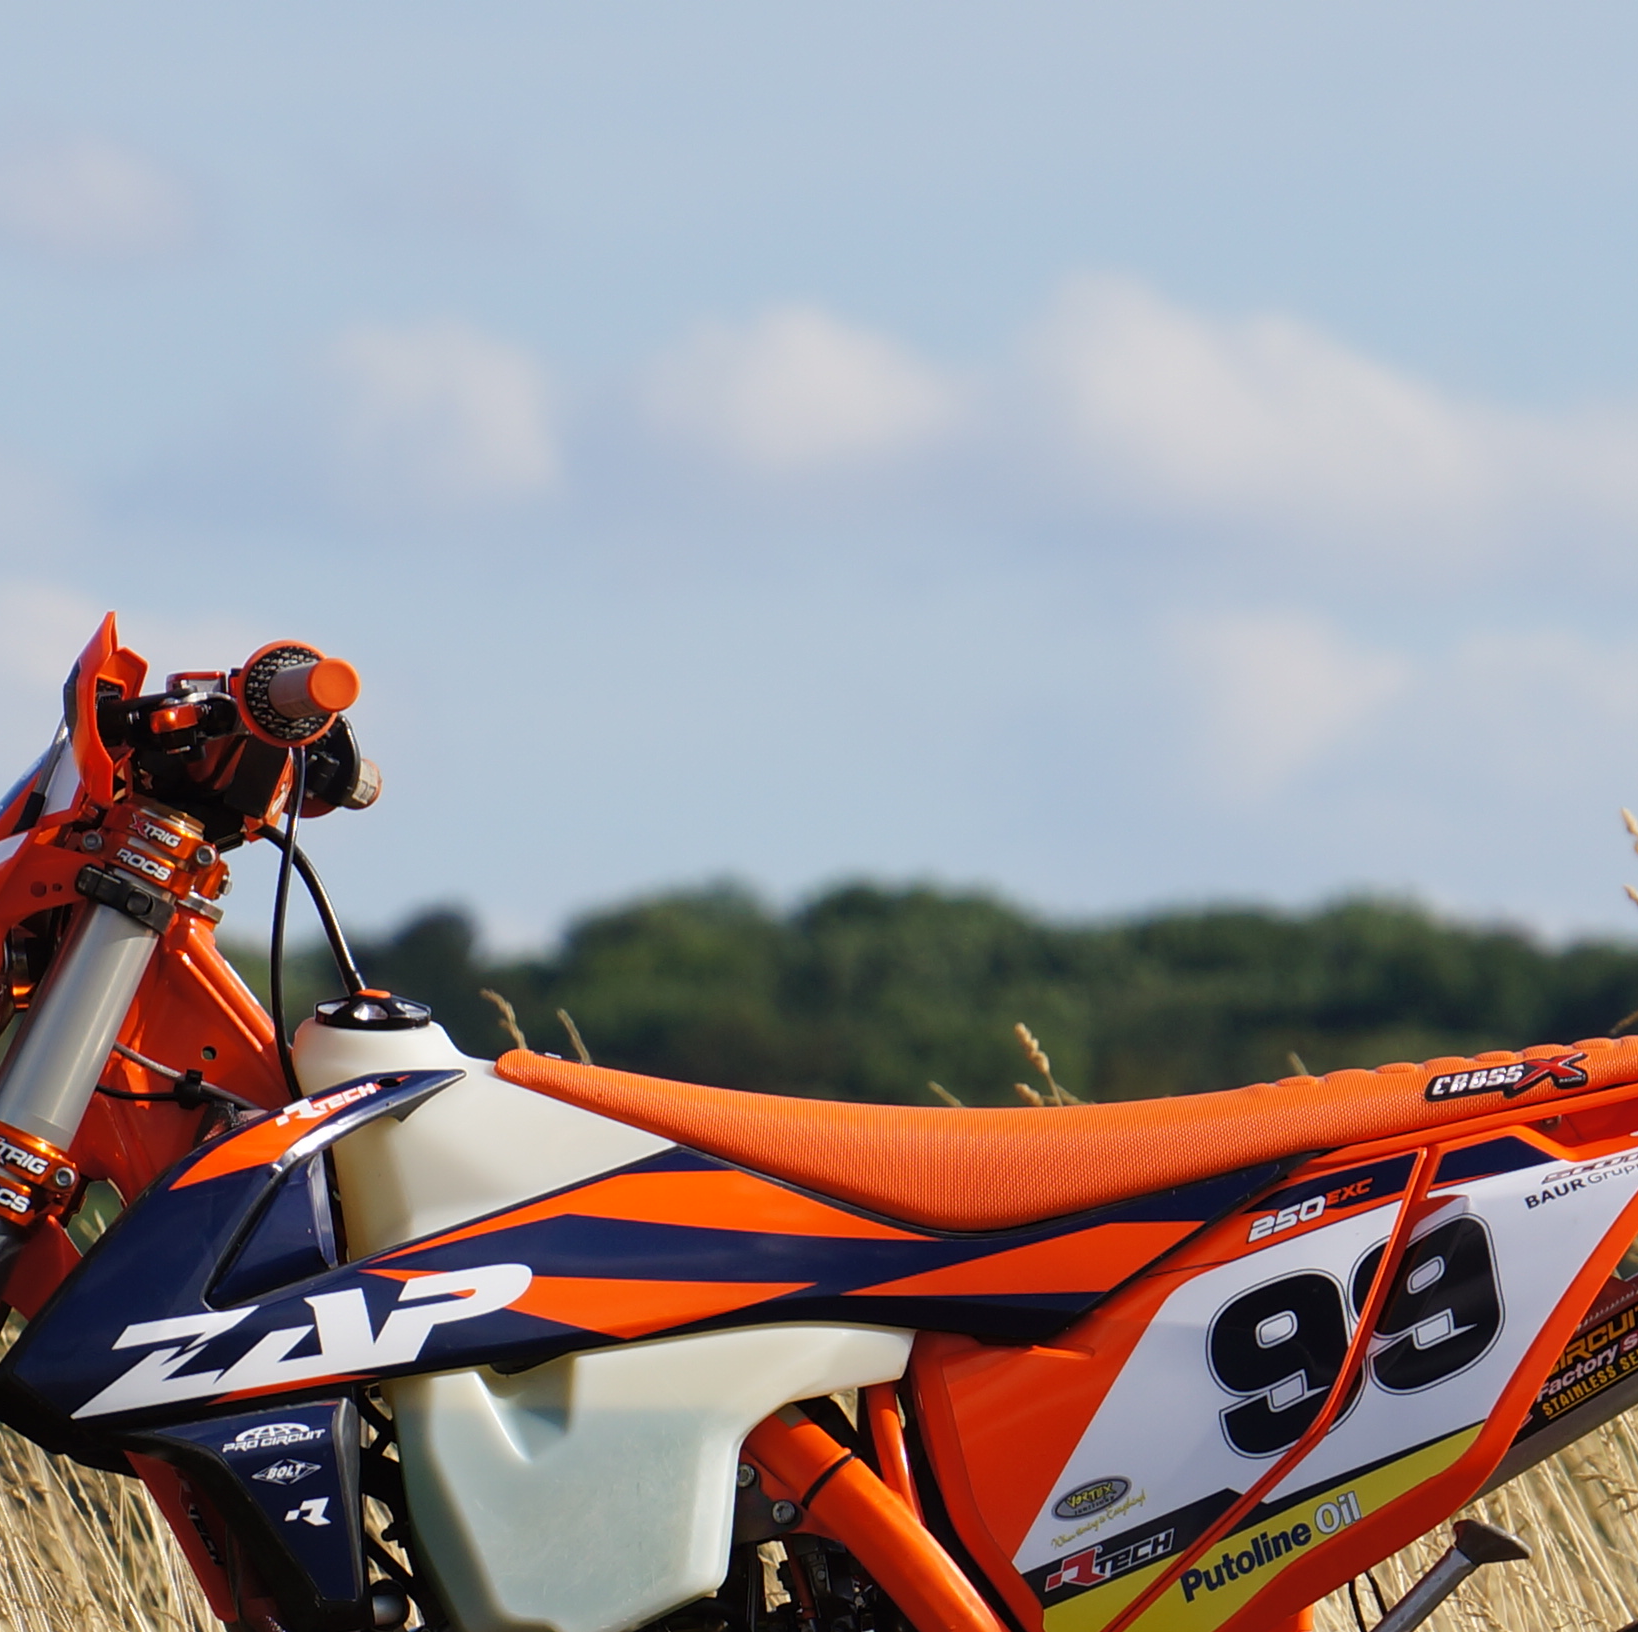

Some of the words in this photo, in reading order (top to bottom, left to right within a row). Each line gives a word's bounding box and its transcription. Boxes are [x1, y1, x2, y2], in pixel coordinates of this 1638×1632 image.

[116, 848, 171, 881] ROCS
[1247, 1195, 1326, 1244] 250
[1325, 1177, 1373, 1206] EXC
[1525, 1178, 1587, 1210] BAUR
[70, 1263, 533, 1418] ZAP
[1205, 1212, 1505, 1459] 99
[1542, 1365, 1618, 1417] STAINLESS
[222, 1440, 259, 1453] PRO
[261, 1428, 326, 1447] CIRCUIT
[266, 1463, 306, 1480] BOLT
[1180, 1522, 1312, 1603] Putoline
[1315, 1491, 1362, 1535] Oil
